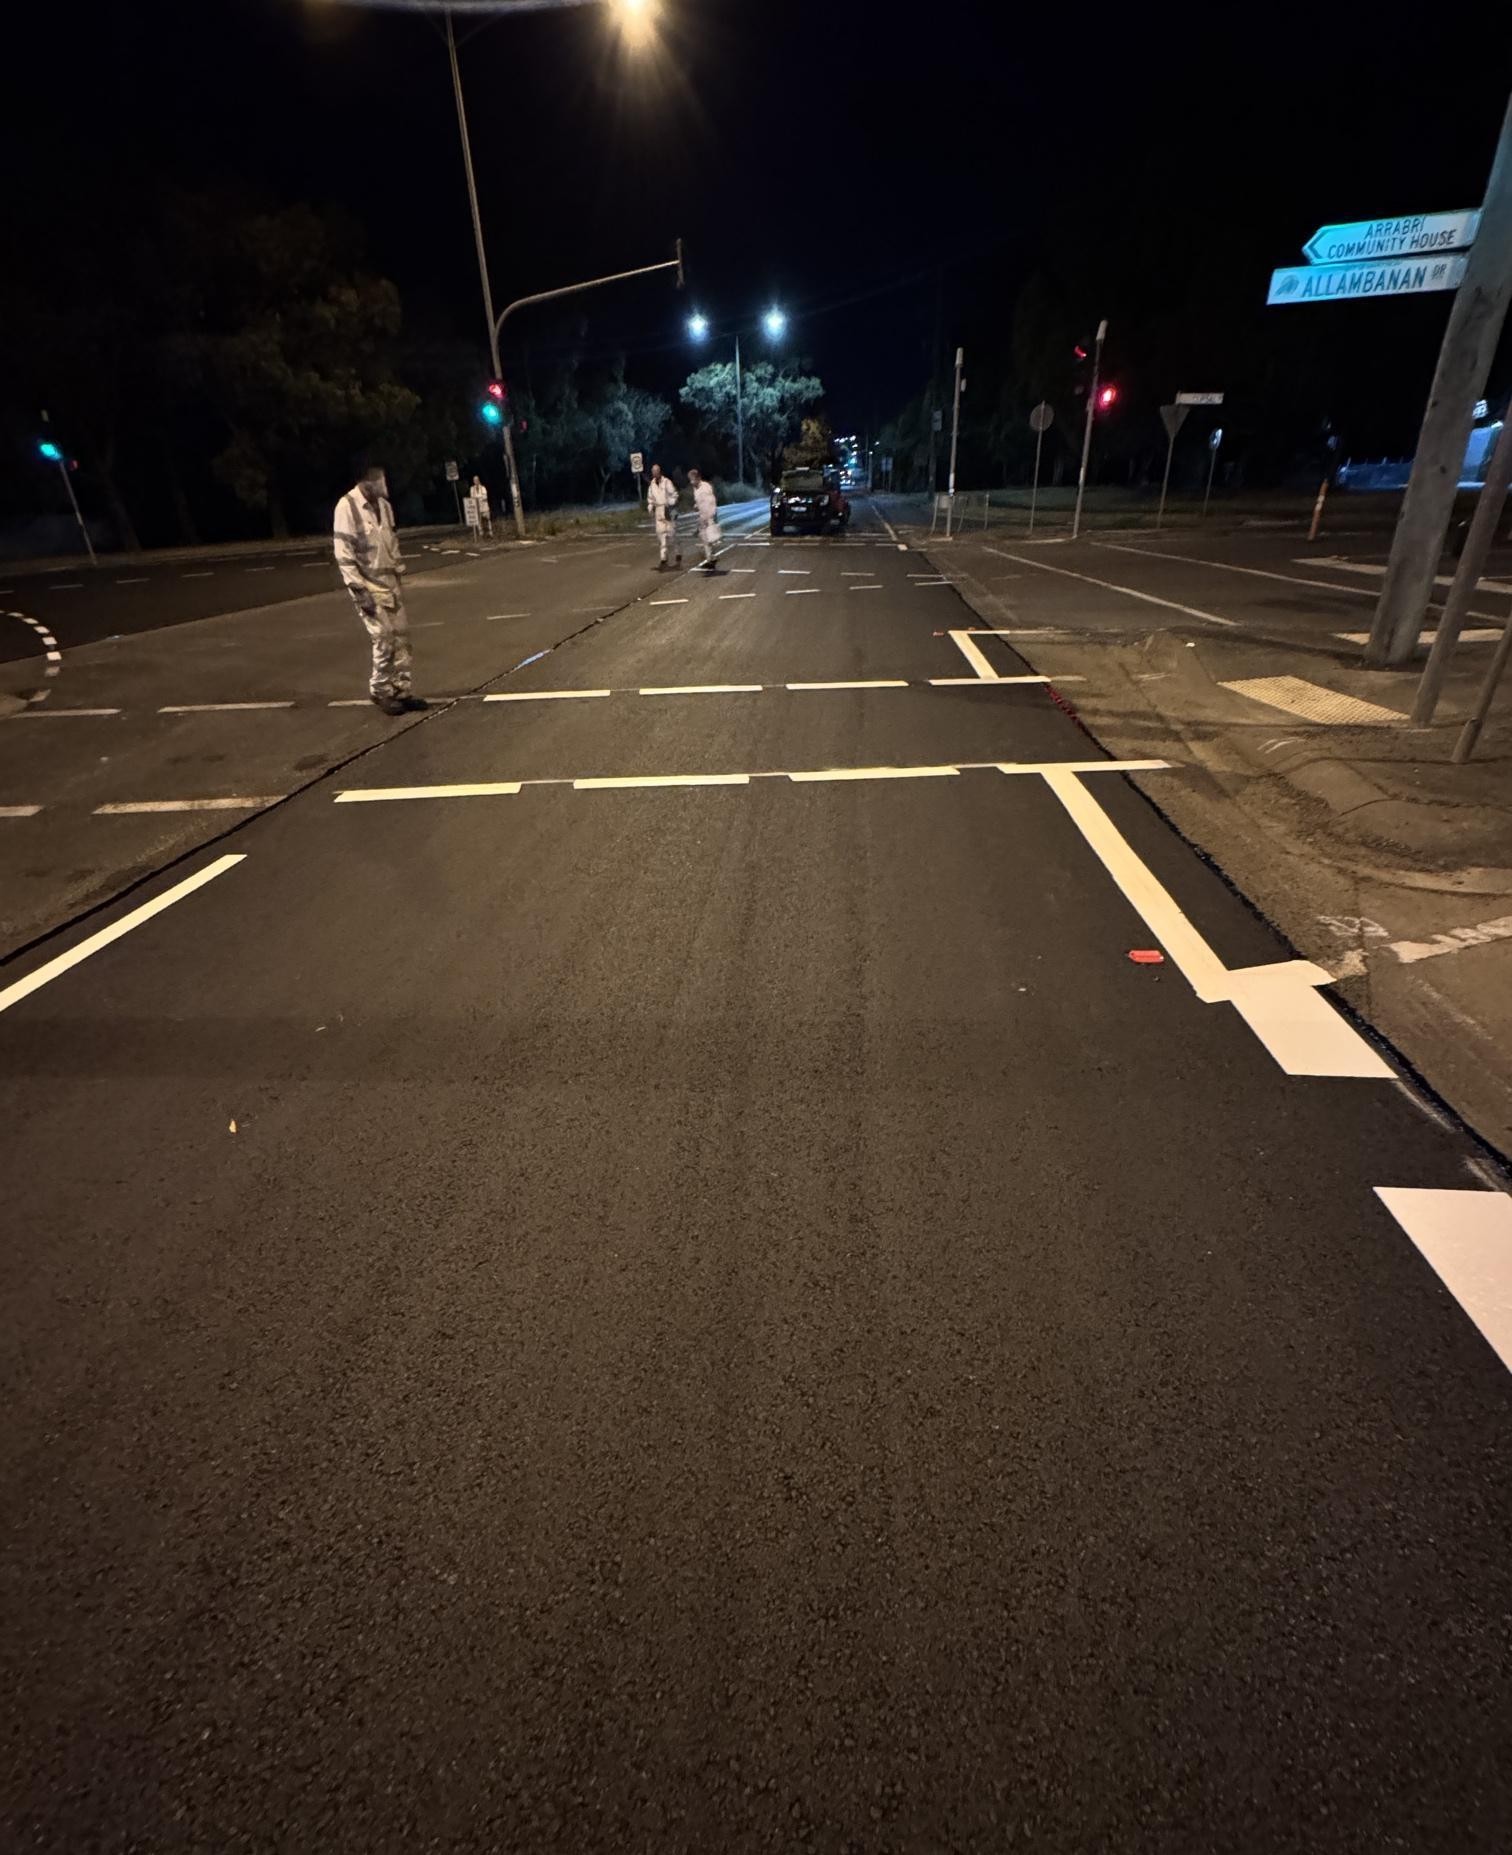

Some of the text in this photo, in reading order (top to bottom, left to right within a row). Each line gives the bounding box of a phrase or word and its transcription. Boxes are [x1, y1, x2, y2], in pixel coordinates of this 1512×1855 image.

[1365, 217, 1426, 239] ARRABRI
[1327, 229, 1456, 260] COMMUNITY HOUSE
[1302, 264, 1447, 298] ALLAMBANAN DR
